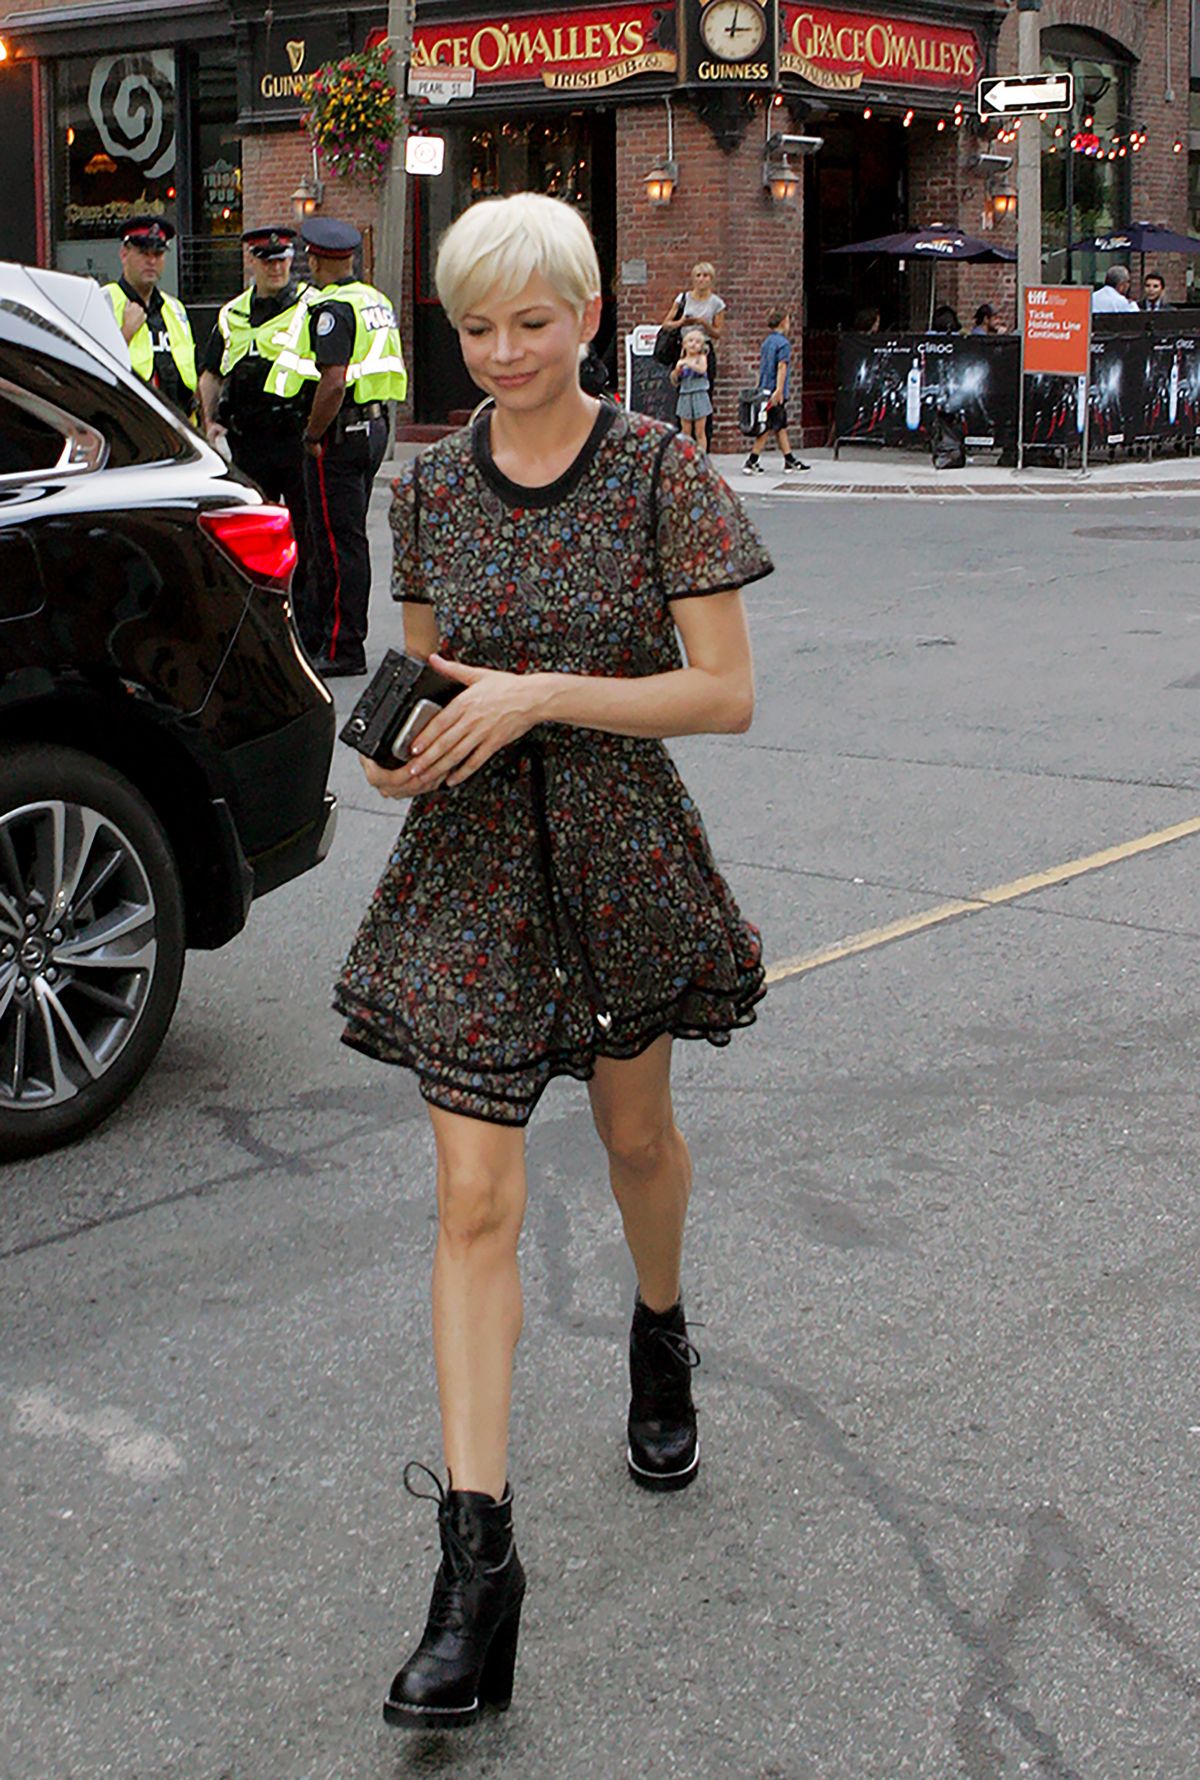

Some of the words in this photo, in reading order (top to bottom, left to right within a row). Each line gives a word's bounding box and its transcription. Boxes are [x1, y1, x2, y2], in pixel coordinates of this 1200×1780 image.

[791, 13, 865, 62] GRACE
[410, 37, 469, 67] ACE
[553, 71, 599, 87] IRISH
[605, 59, 637, 82] PUB
[698, 61, 769, 80] GUINNESS
[781, 54, 855, 88] RESTAURANT
[418, 81, 445, 95] PEARL
[451, 82, 462, 95] ST
[1029, 309, 1055, 320] Ticket
[1028, 320, 1061, 330] Holders
[1062, 321, 1082, 332] Line
[1028, 329, 1071, 341] Continued
